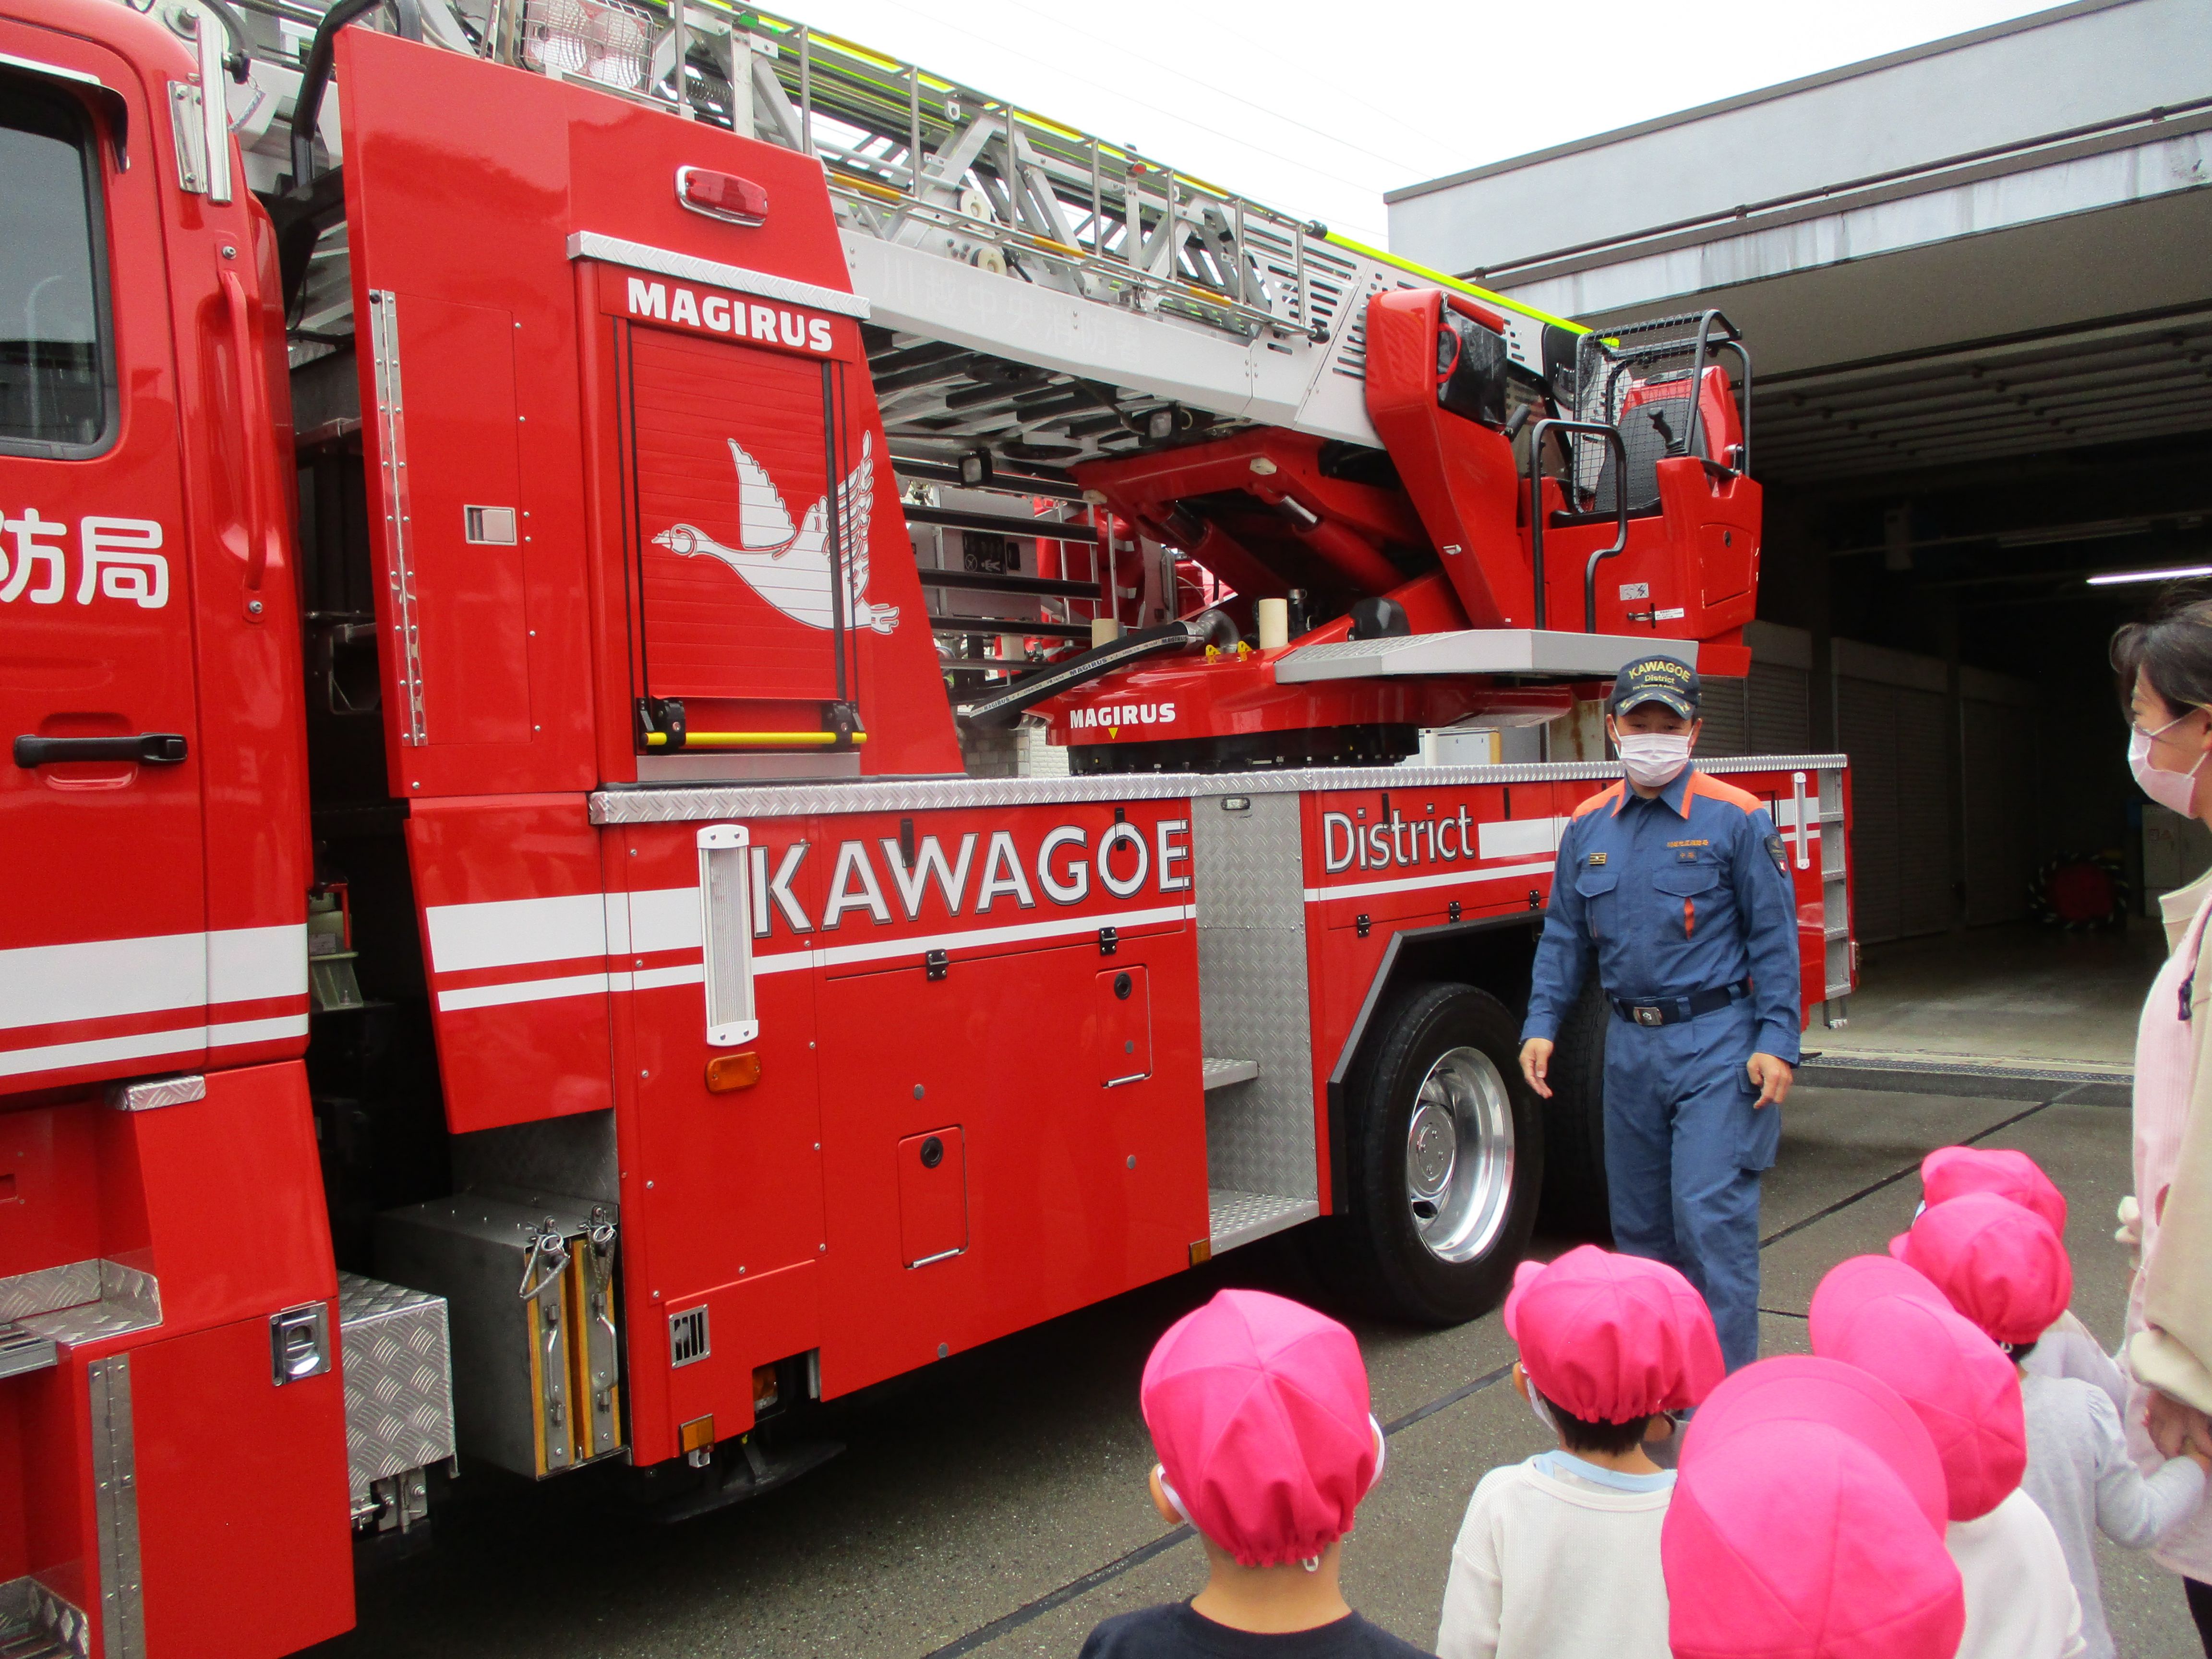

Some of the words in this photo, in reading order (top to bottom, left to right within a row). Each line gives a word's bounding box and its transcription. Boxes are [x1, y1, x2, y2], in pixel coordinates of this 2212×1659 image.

[627, 277, 832, 352] MAGIRUS
[883, 253, 1142, 364] 川越中央消防署
[1070, 659, 1107, 676] MAGIRUS
[1629, 661, 1691, 683] KAWAGOE
[1645, 675, 1675, 684] District
[984, 697, 1010, 710] MAGIRUS
[1070, 703, 1176, 729] MAGIRUS
[1324, 803, 1475, 874] District
[751, 819, 1192, 938] KAWAGOE
